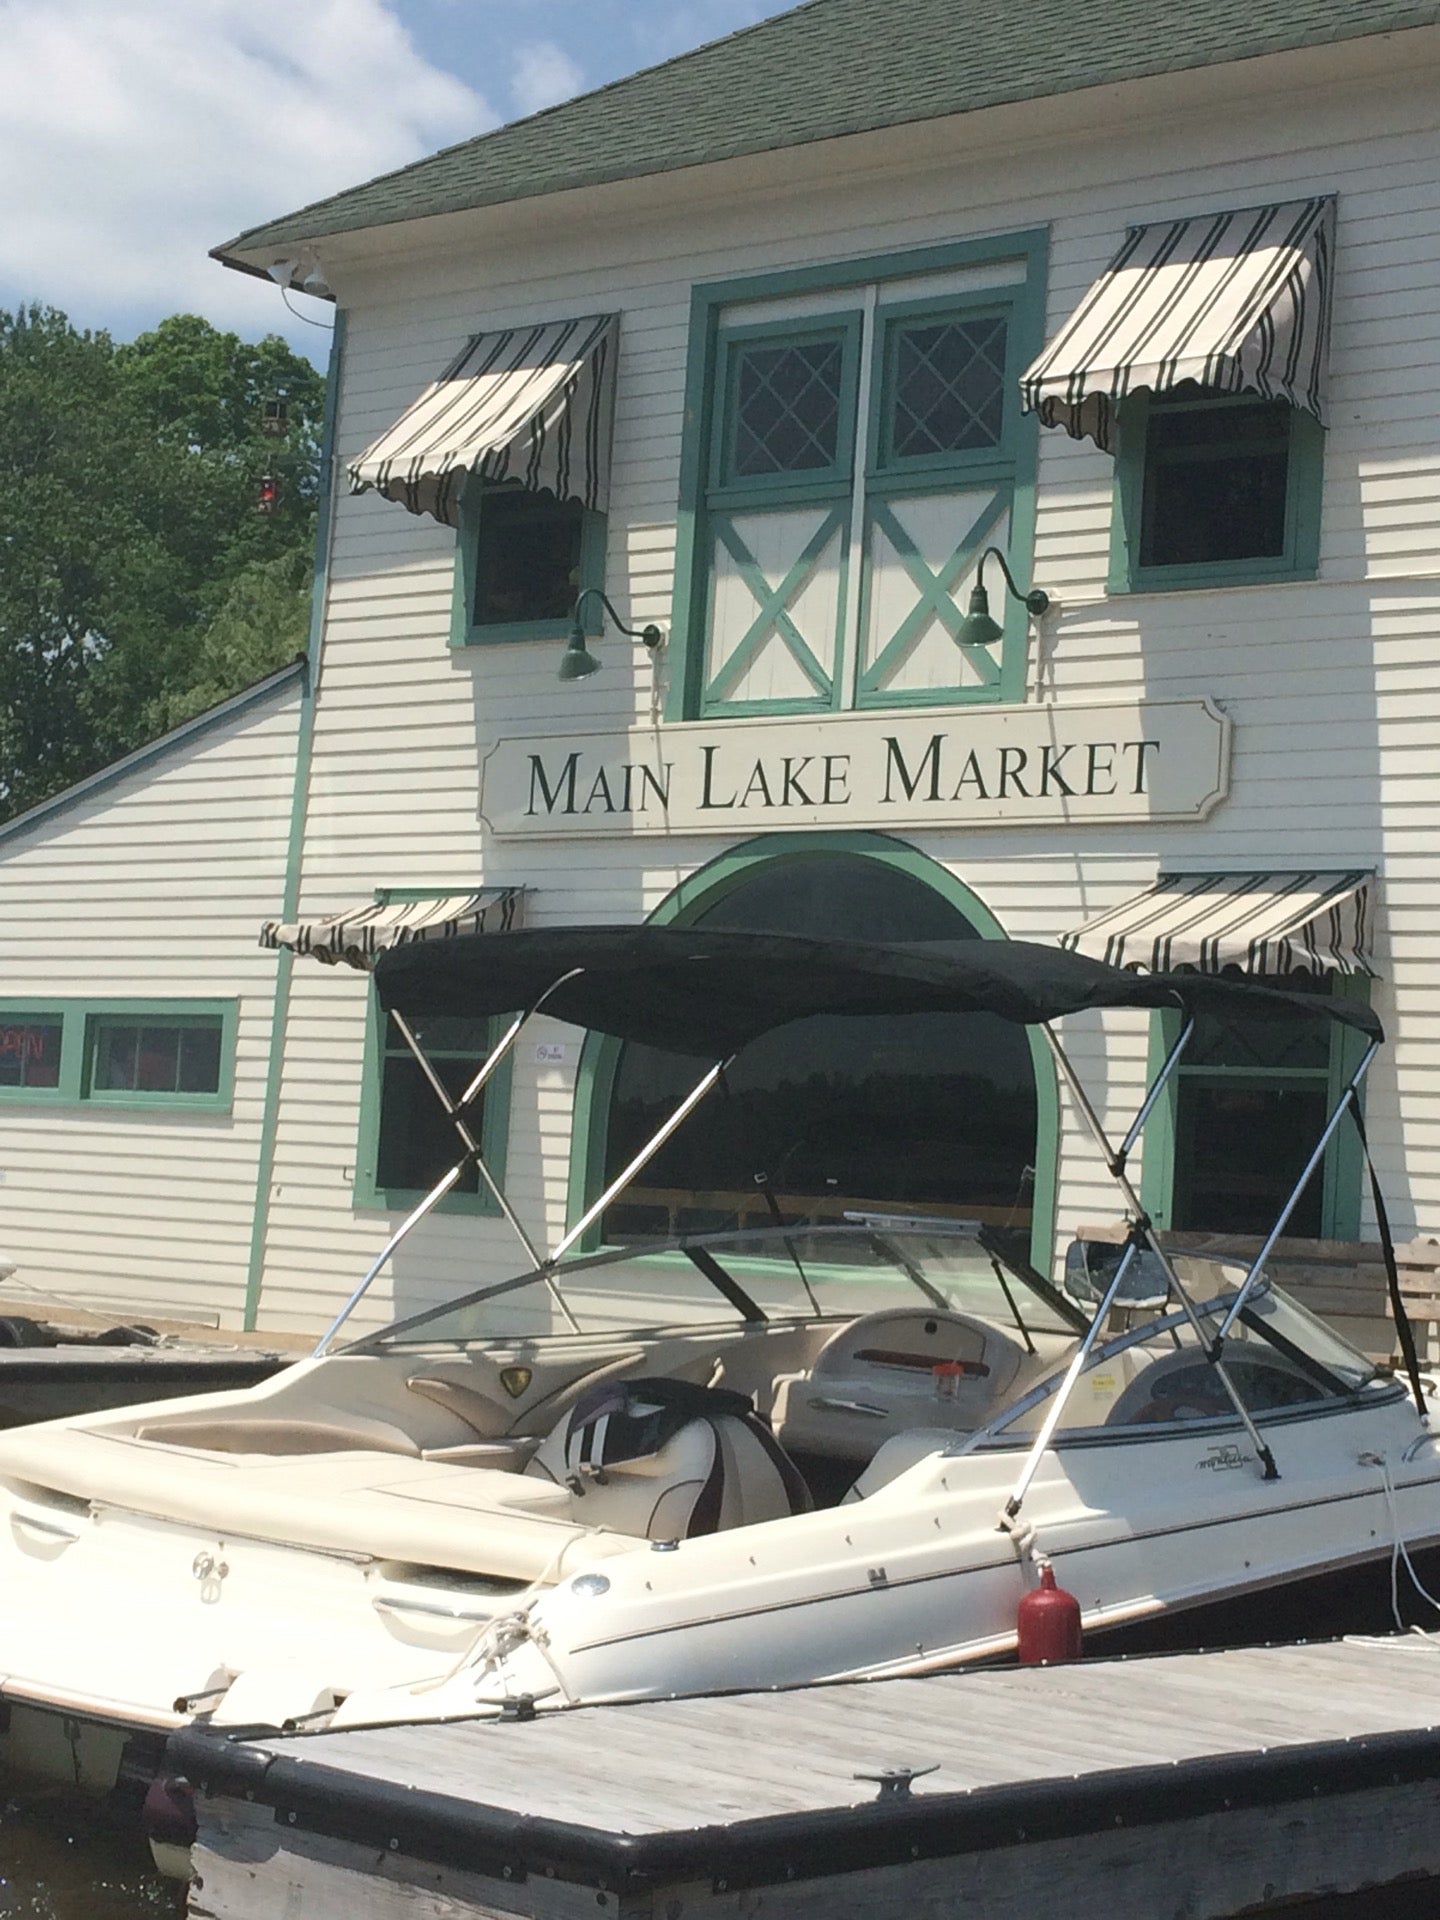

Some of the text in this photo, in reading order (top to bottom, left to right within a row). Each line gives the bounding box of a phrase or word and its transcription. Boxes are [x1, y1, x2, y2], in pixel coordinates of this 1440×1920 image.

[523, 733, 1161, 816] MAIN LAKE MARKET
